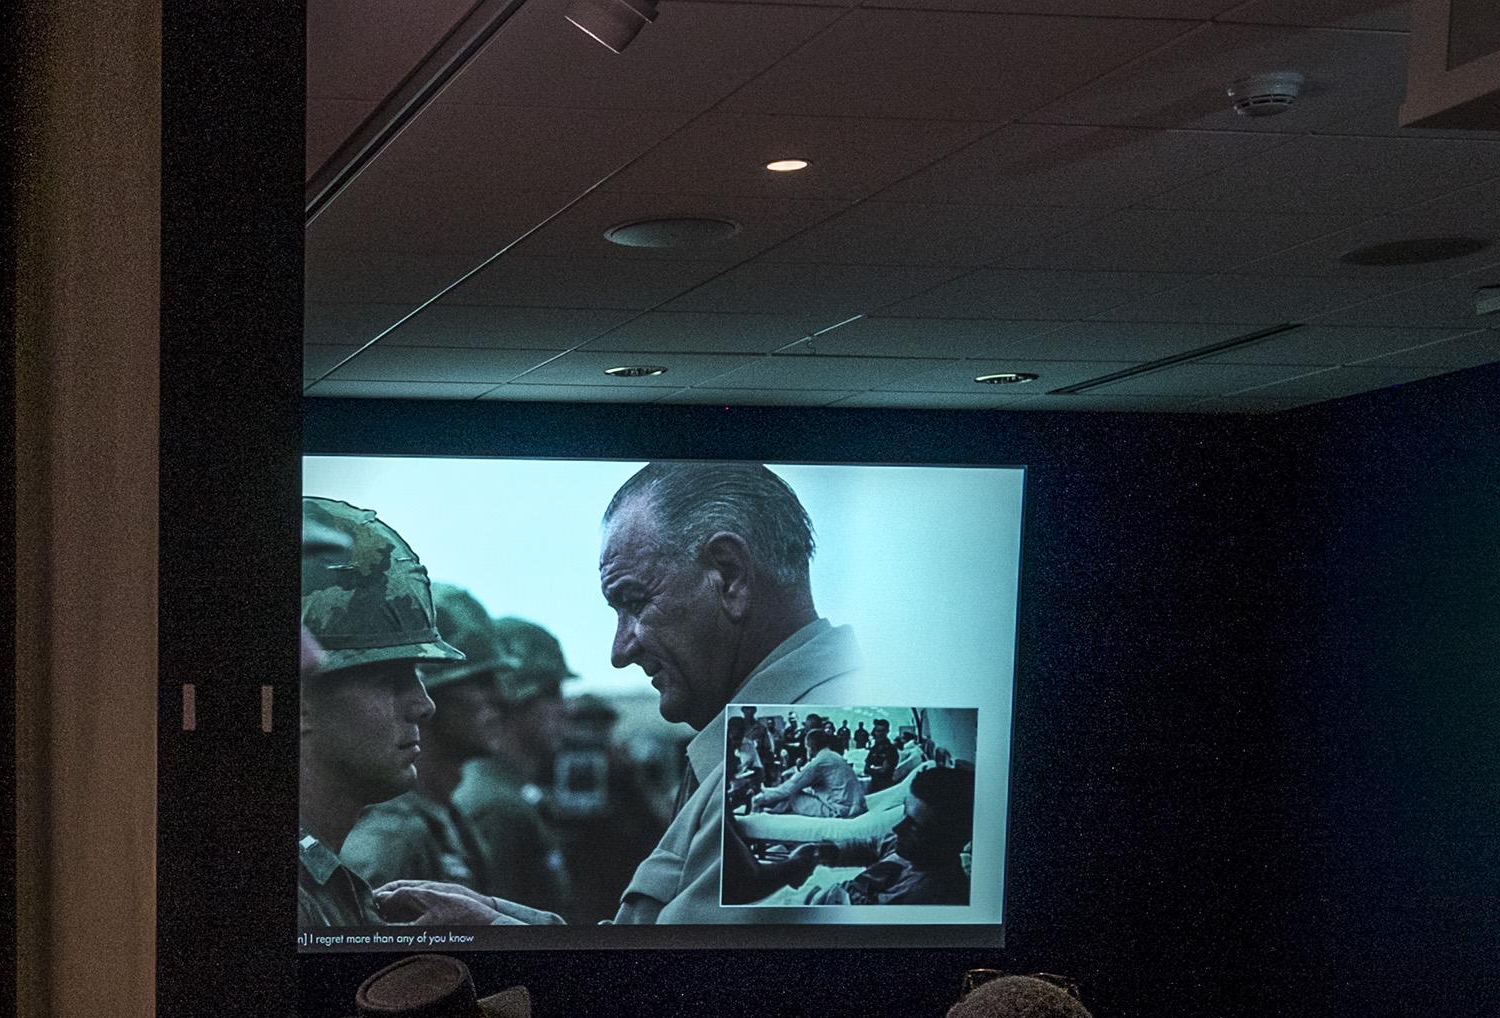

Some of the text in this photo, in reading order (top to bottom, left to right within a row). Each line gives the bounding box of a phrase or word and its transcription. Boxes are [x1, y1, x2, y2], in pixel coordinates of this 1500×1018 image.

[315, 934, 344, 946] regret
[347, 935, 371, 944] more
[373, 932, 394, 944] than
[396, 935, 415, 946] any
[417, 931, 428, 943] of
[428, 935, 447, 946] you
[449, 931, 475, 943] know
